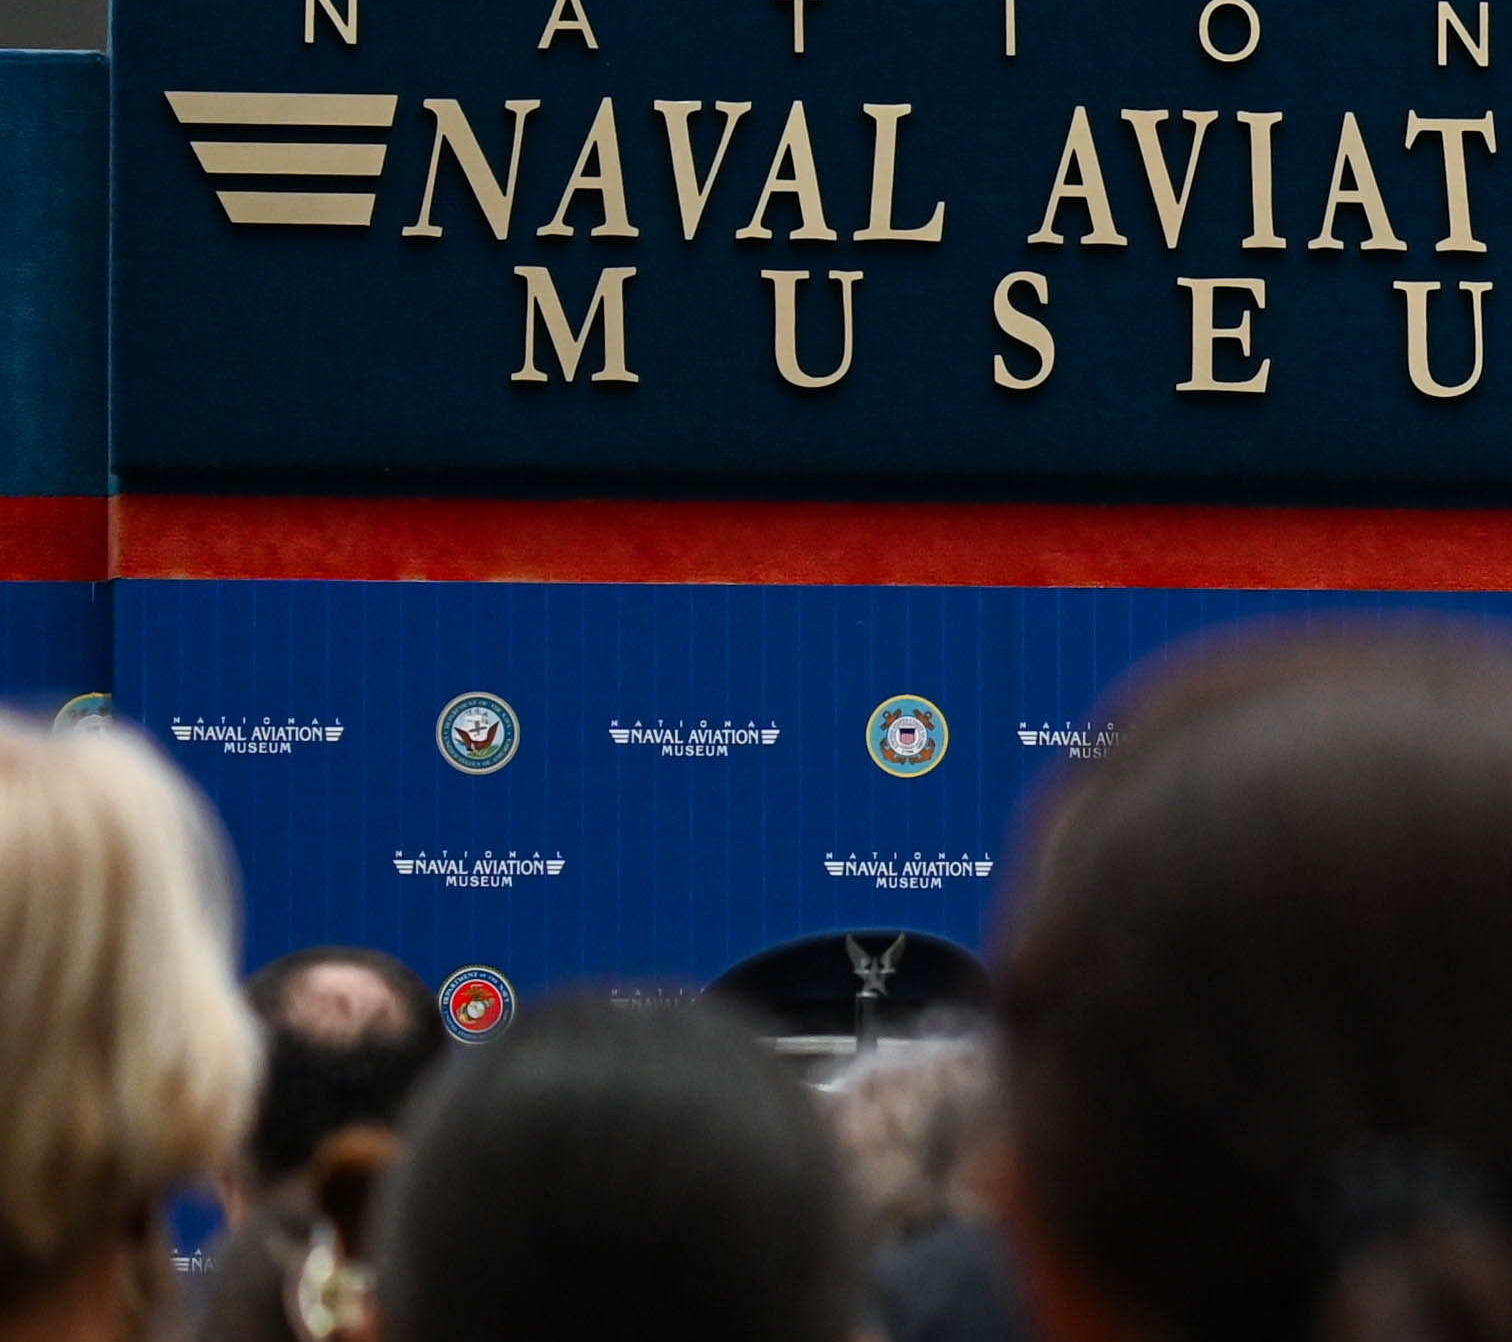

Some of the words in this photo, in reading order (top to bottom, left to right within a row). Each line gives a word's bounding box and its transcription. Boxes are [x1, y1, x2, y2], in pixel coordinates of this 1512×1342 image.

[401, 96, 945, 242] NAVAL
[1019, 721, 1114, 730] NATIO
[193, 726, 247, 741] NAVAL
[250, 726, 323, 741] AVIATION
[631, 729, 684, 744] NAVAL
[688, 729, 759, 744] AVIATION
[1039, 731, 1091, 746] NAVAL
[223, 742, 292, 754] MUSEUM
[661, 745, 729, 757] MUSEUM
[415, 860, 468, 875] NAVAL
[472, 860, 544, 875] AVIATION
[845, 861, 898, 876] NAVAL
[902, 861, 973, 876] AVIATION
[445, 876, 513, 887] MUSEUM
[875, 877, 942, 889] MUSEUM
